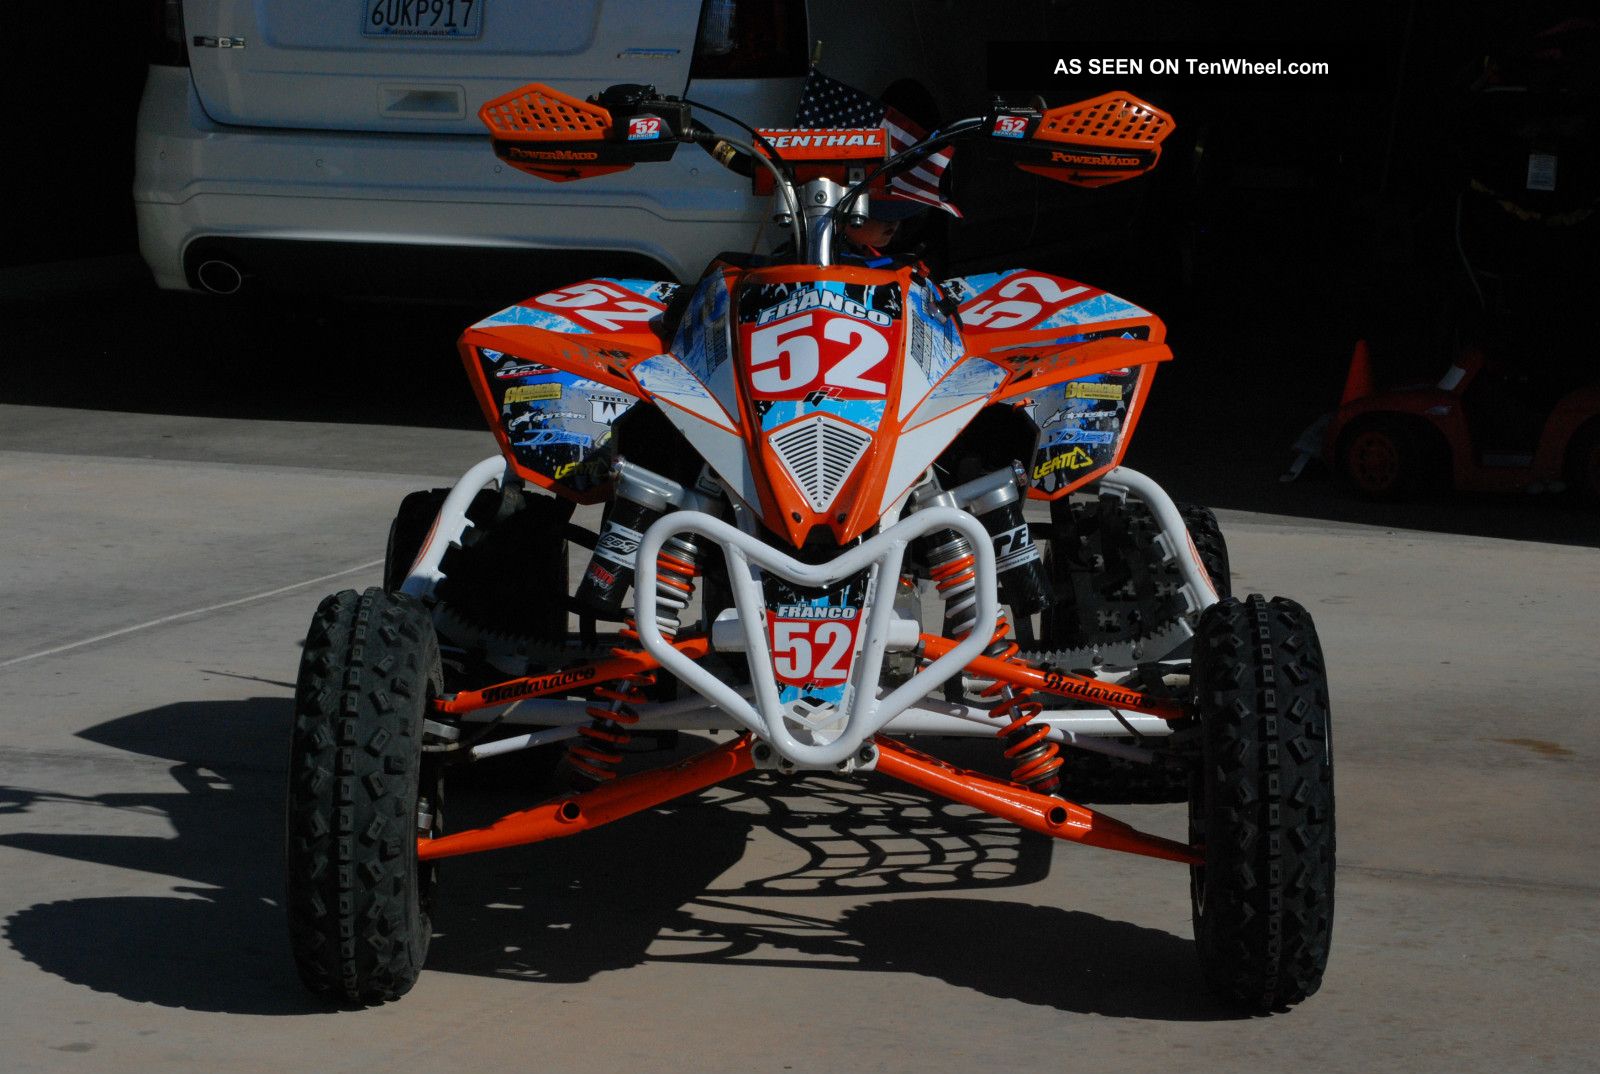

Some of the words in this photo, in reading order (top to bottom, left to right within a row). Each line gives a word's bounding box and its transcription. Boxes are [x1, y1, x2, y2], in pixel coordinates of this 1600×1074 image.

[371, 0, 474, 27] 6UKP917
[635, 120, 659, 134] 52
[1001, 119, 1025, 133] 52
[535, 283, 665, 331] 52
[757, 288, 892, 327] FRANCO
[959, 276, 1091, 329] 52
[751, 313, 889, 395] 52
[778, 606, 857, 619] FRANCO
[774, 621, 852, 679] 52
